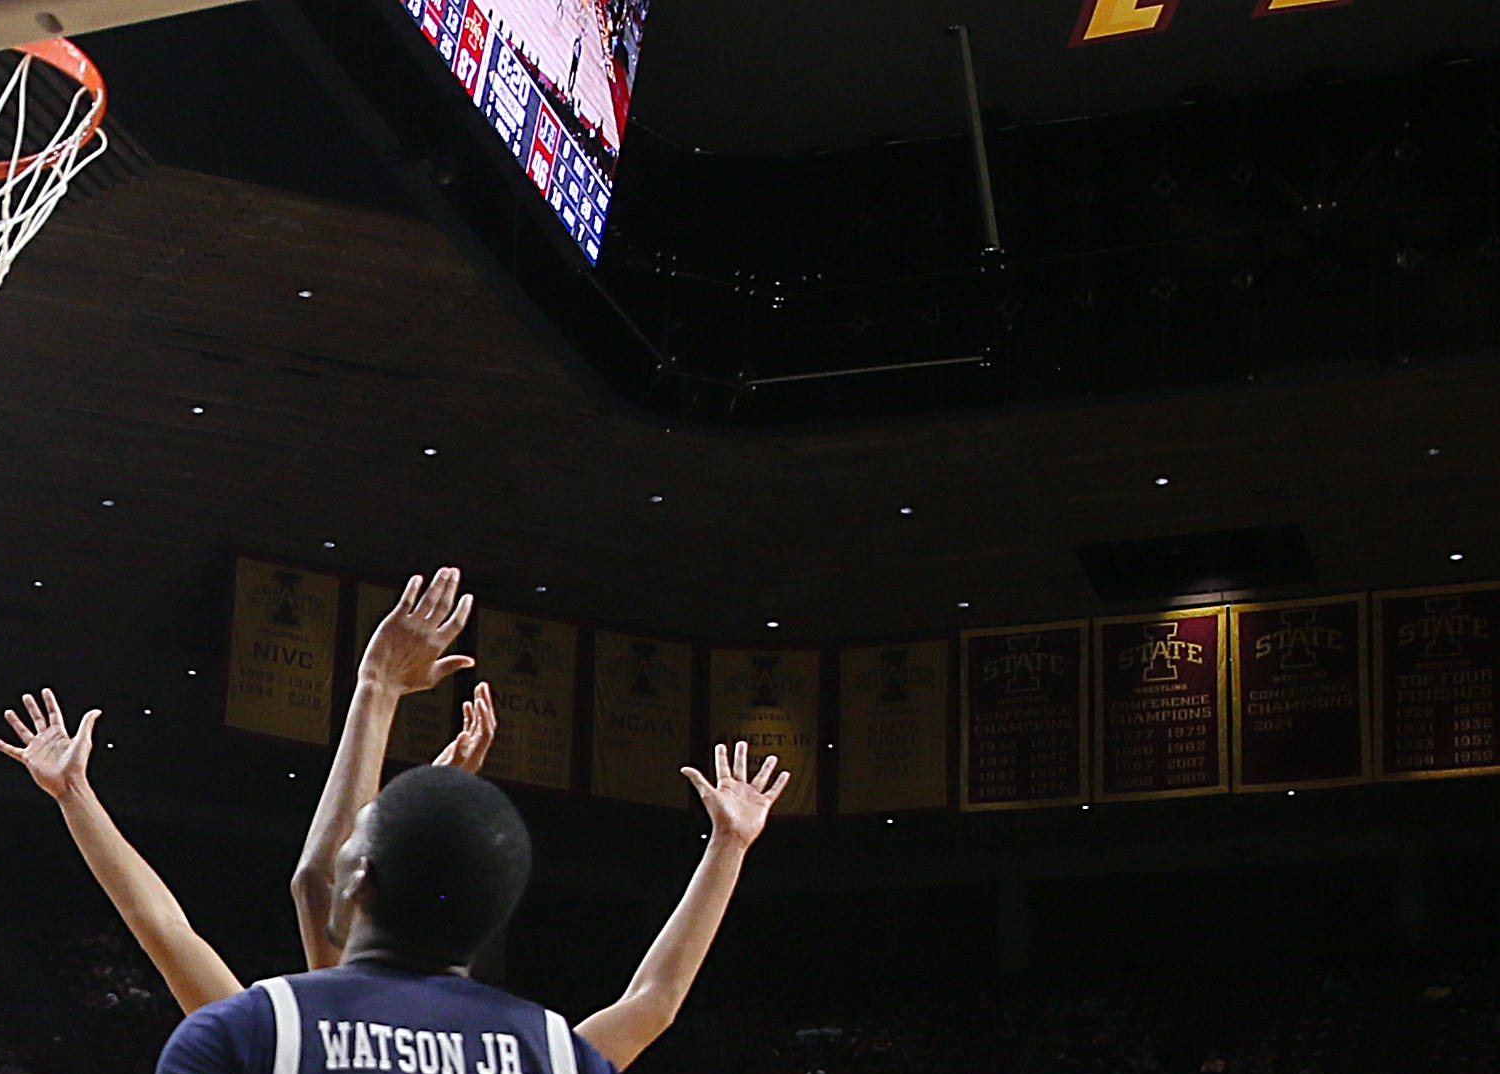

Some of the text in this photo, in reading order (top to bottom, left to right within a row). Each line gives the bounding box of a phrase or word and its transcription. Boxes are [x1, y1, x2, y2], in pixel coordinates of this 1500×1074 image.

[456, 47, 478, 90] 87
[530, 150, 549, 191] 46
[1255, 626, 1344, 660] STATE
[1397, 614, 1491, 647] STATE
[253, 640, 314, 670] NIVC
[983, 651, 1066, 681] STATE
[1119, 640, 1204, 671] STATE
[1396, 673, 1435, 688] TOP
[494, 692, 558, 719] NCAA
[1109, 706, 1212, 726] CHAMPIONS
[1247, 695, 1355, 715] CHAMPIONS
[610, 711, 674, 737] NCAA
[974, 718, 1075, 735] CHAMPIONS
[1167, 725, 1206, 739] 1979
[1167, 756, 1206, 770] 2007
